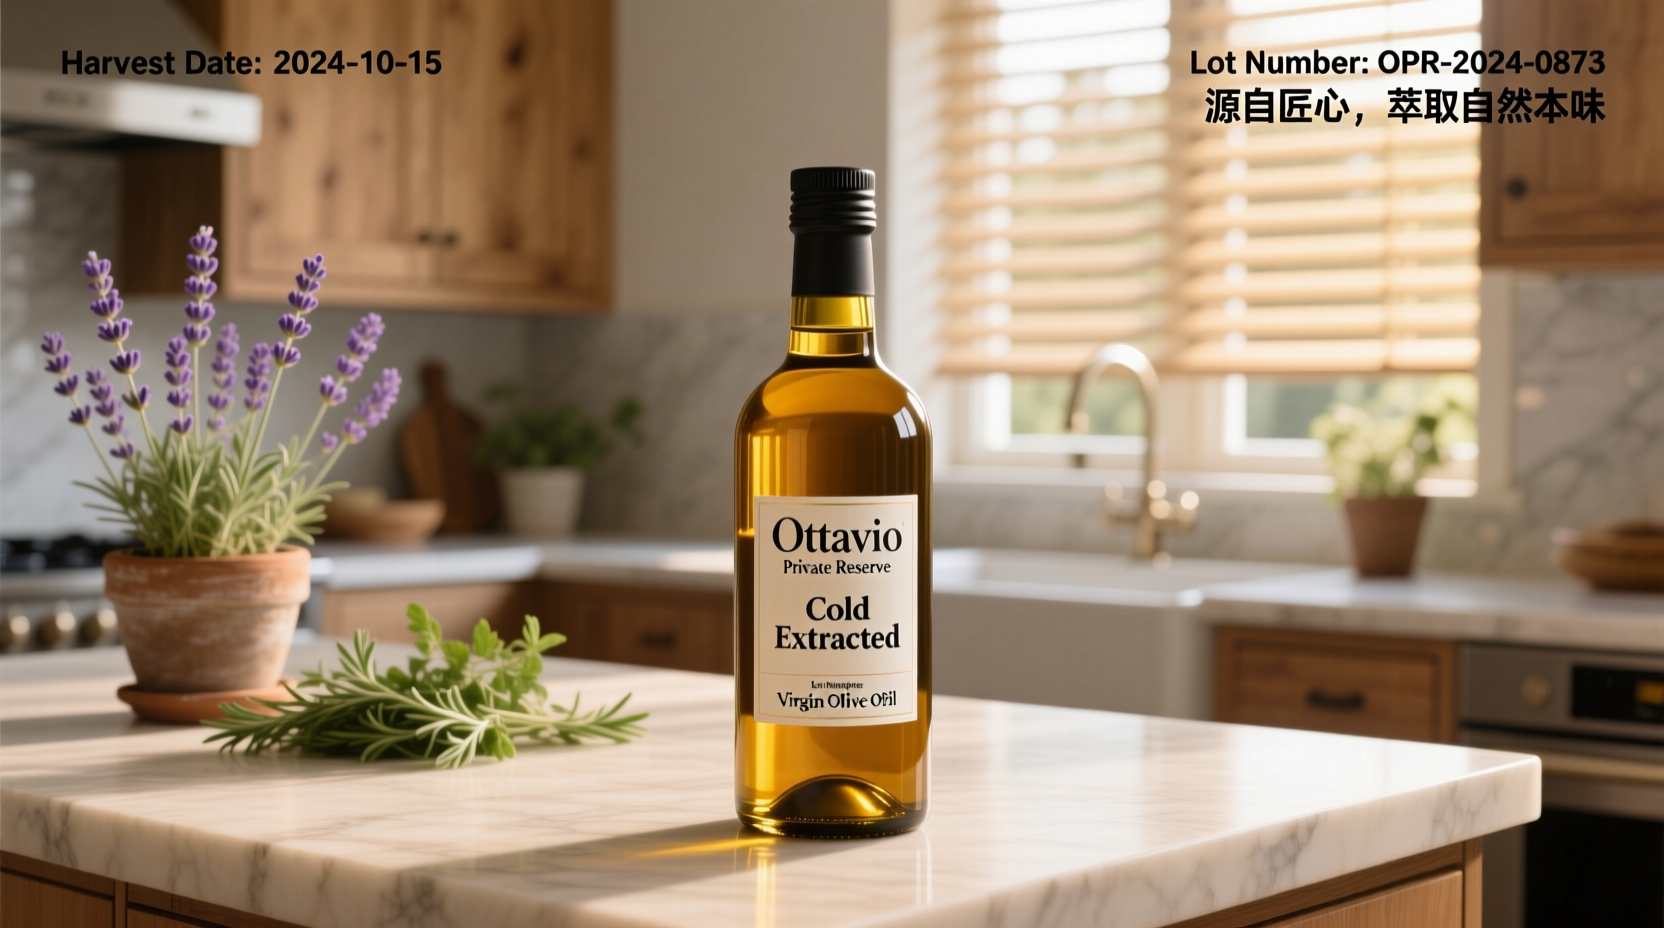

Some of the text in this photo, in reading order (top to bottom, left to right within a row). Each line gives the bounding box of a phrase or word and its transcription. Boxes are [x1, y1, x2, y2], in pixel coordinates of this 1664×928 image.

[772, 517, 902, 553] Ottavio
[783, 559, 891, 575] Private Reserve
[806, 596, 870, 621] Cold
[775, 623, 900, 650] Extracted
[776, 692, 824, 712] Virgin
[828, 693, 868, 708] Olive
